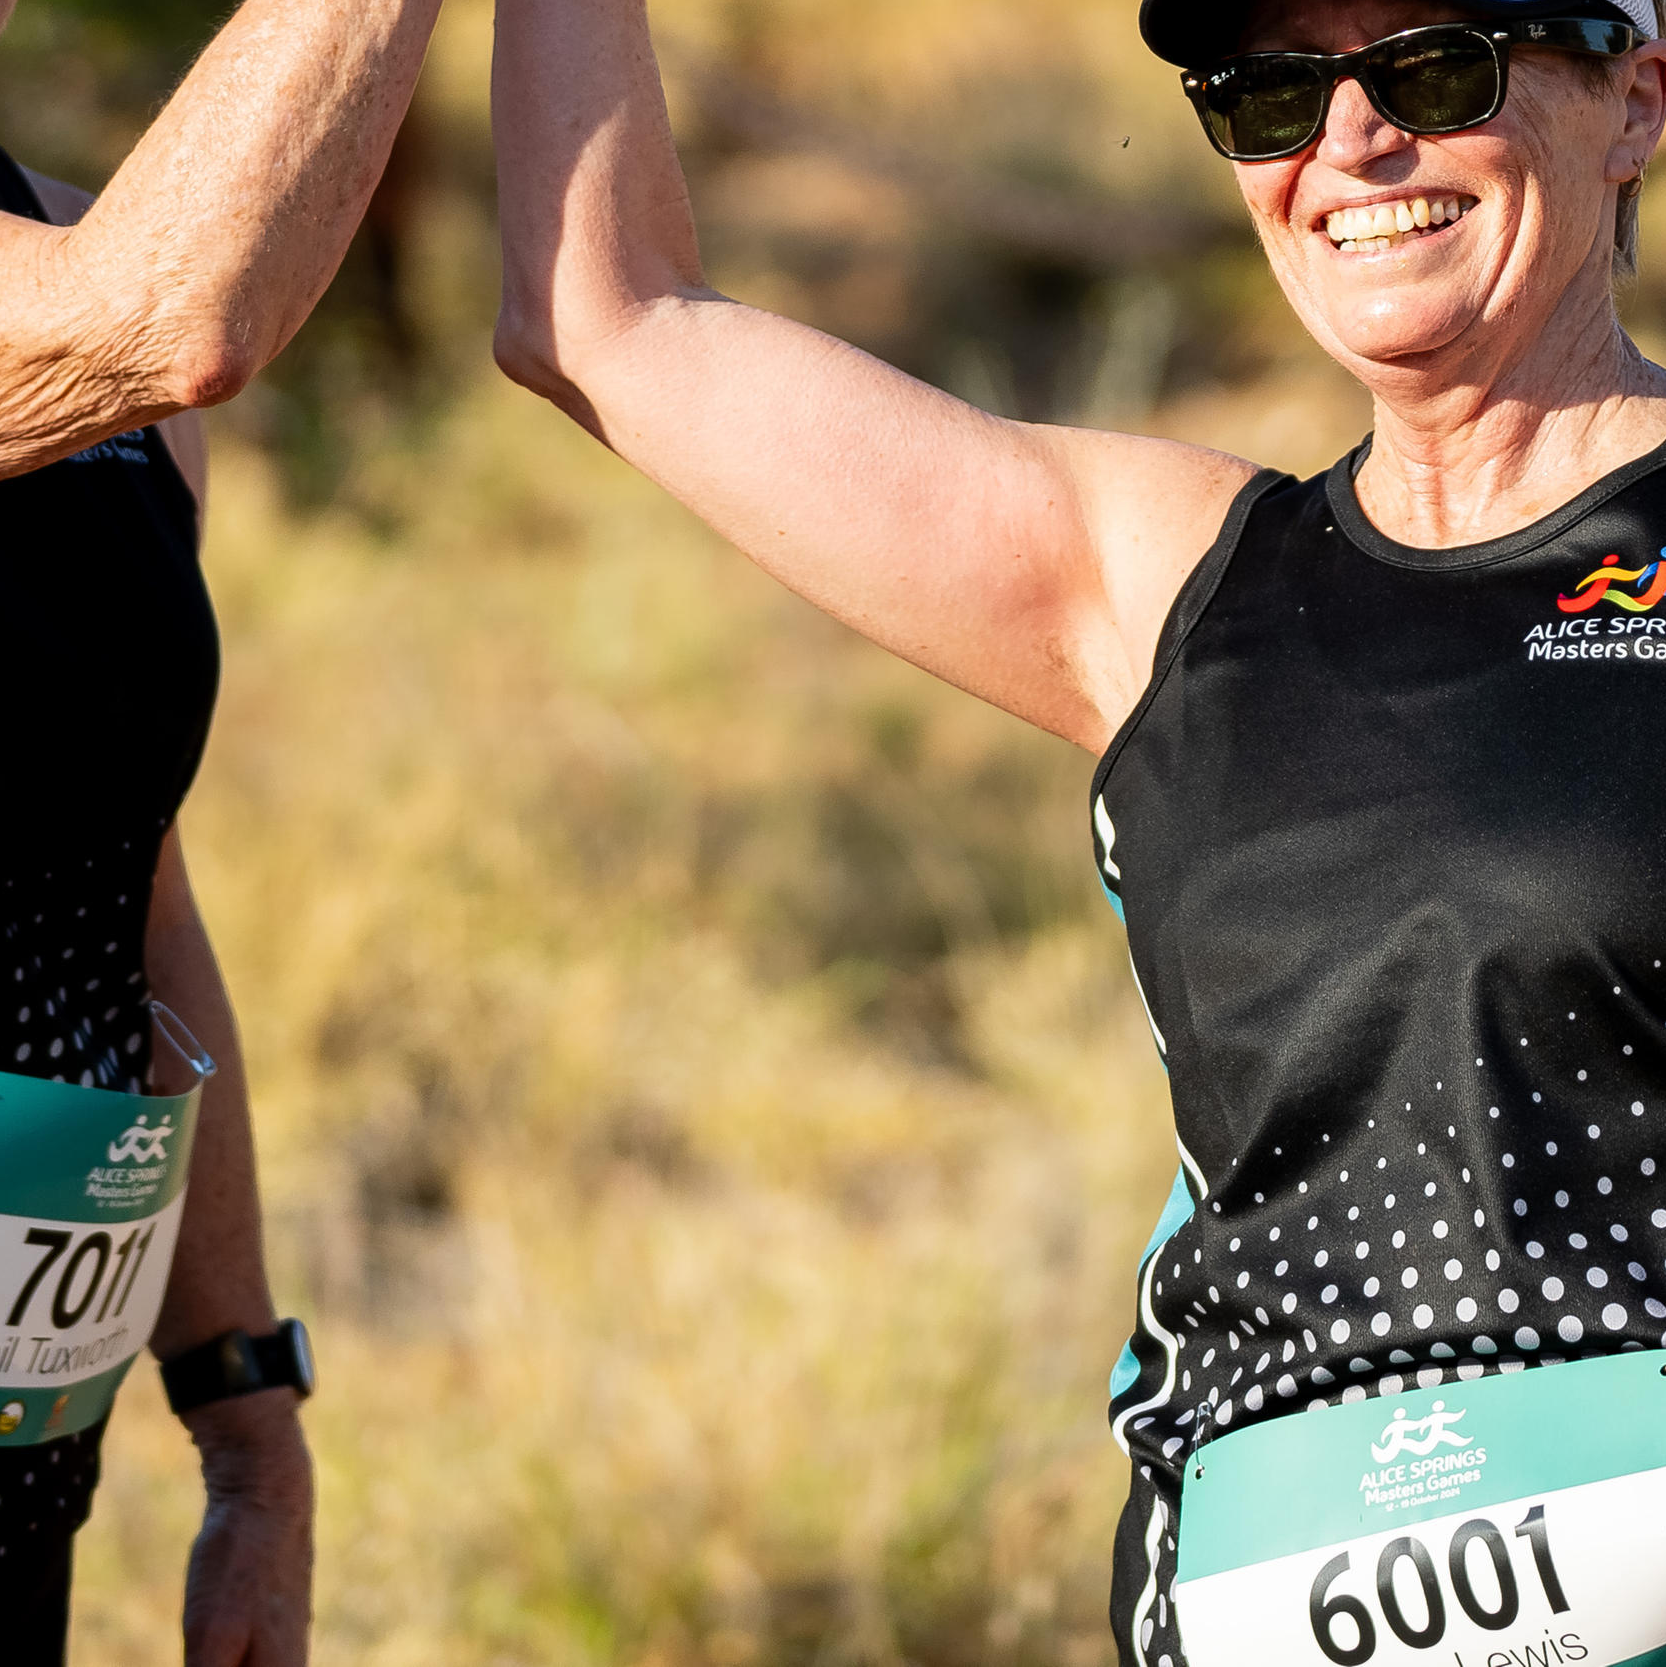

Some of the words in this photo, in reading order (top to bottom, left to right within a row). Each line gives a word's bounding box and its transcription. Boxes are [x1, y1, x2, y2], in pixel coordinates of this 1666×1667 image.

[1523, 618, 1602, 643] ALICE
[1528, 639, 1628, 661] Masters
[5, 1221, 157, 1330] 7011
[1358, 1464, 1406, 1492] ALICE
[1409, 1446, 1487, 1480] SPRINGS
[1364, 1481, 1425, 1507] Masters
[1426, 1468, 1482, 1492] Games
[1308, 1503, 1571, 1667] 6001
